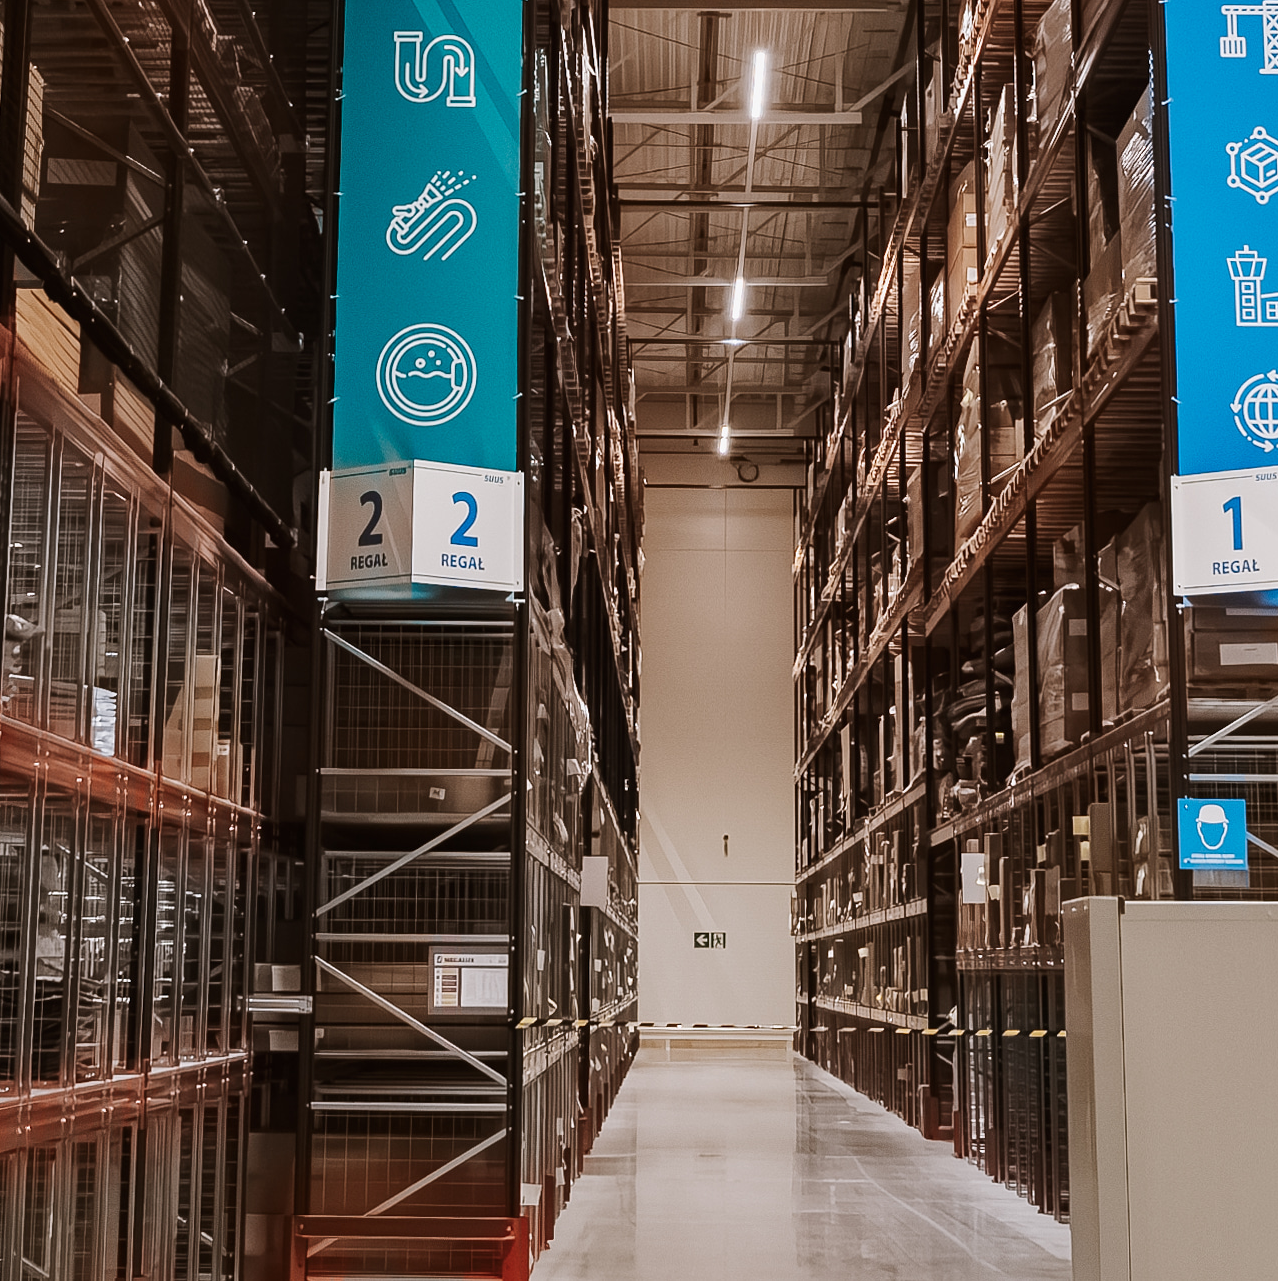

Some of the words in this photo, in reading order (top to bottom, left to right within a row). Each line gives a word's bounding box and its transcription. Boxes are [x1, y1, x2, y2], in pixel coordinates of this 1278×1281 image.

[1255, 472, 1277, 481] SUUS
[358, 490, 383, 547] 2
[450, 491, 479, 547] 2
[1223, 496, 1243, 551] 1
[350, 553, 388, 570] REGAŁ
[441, 553, 485, 571] REGAŁ
[1212, 559, 1260, 575] REGAŁ
